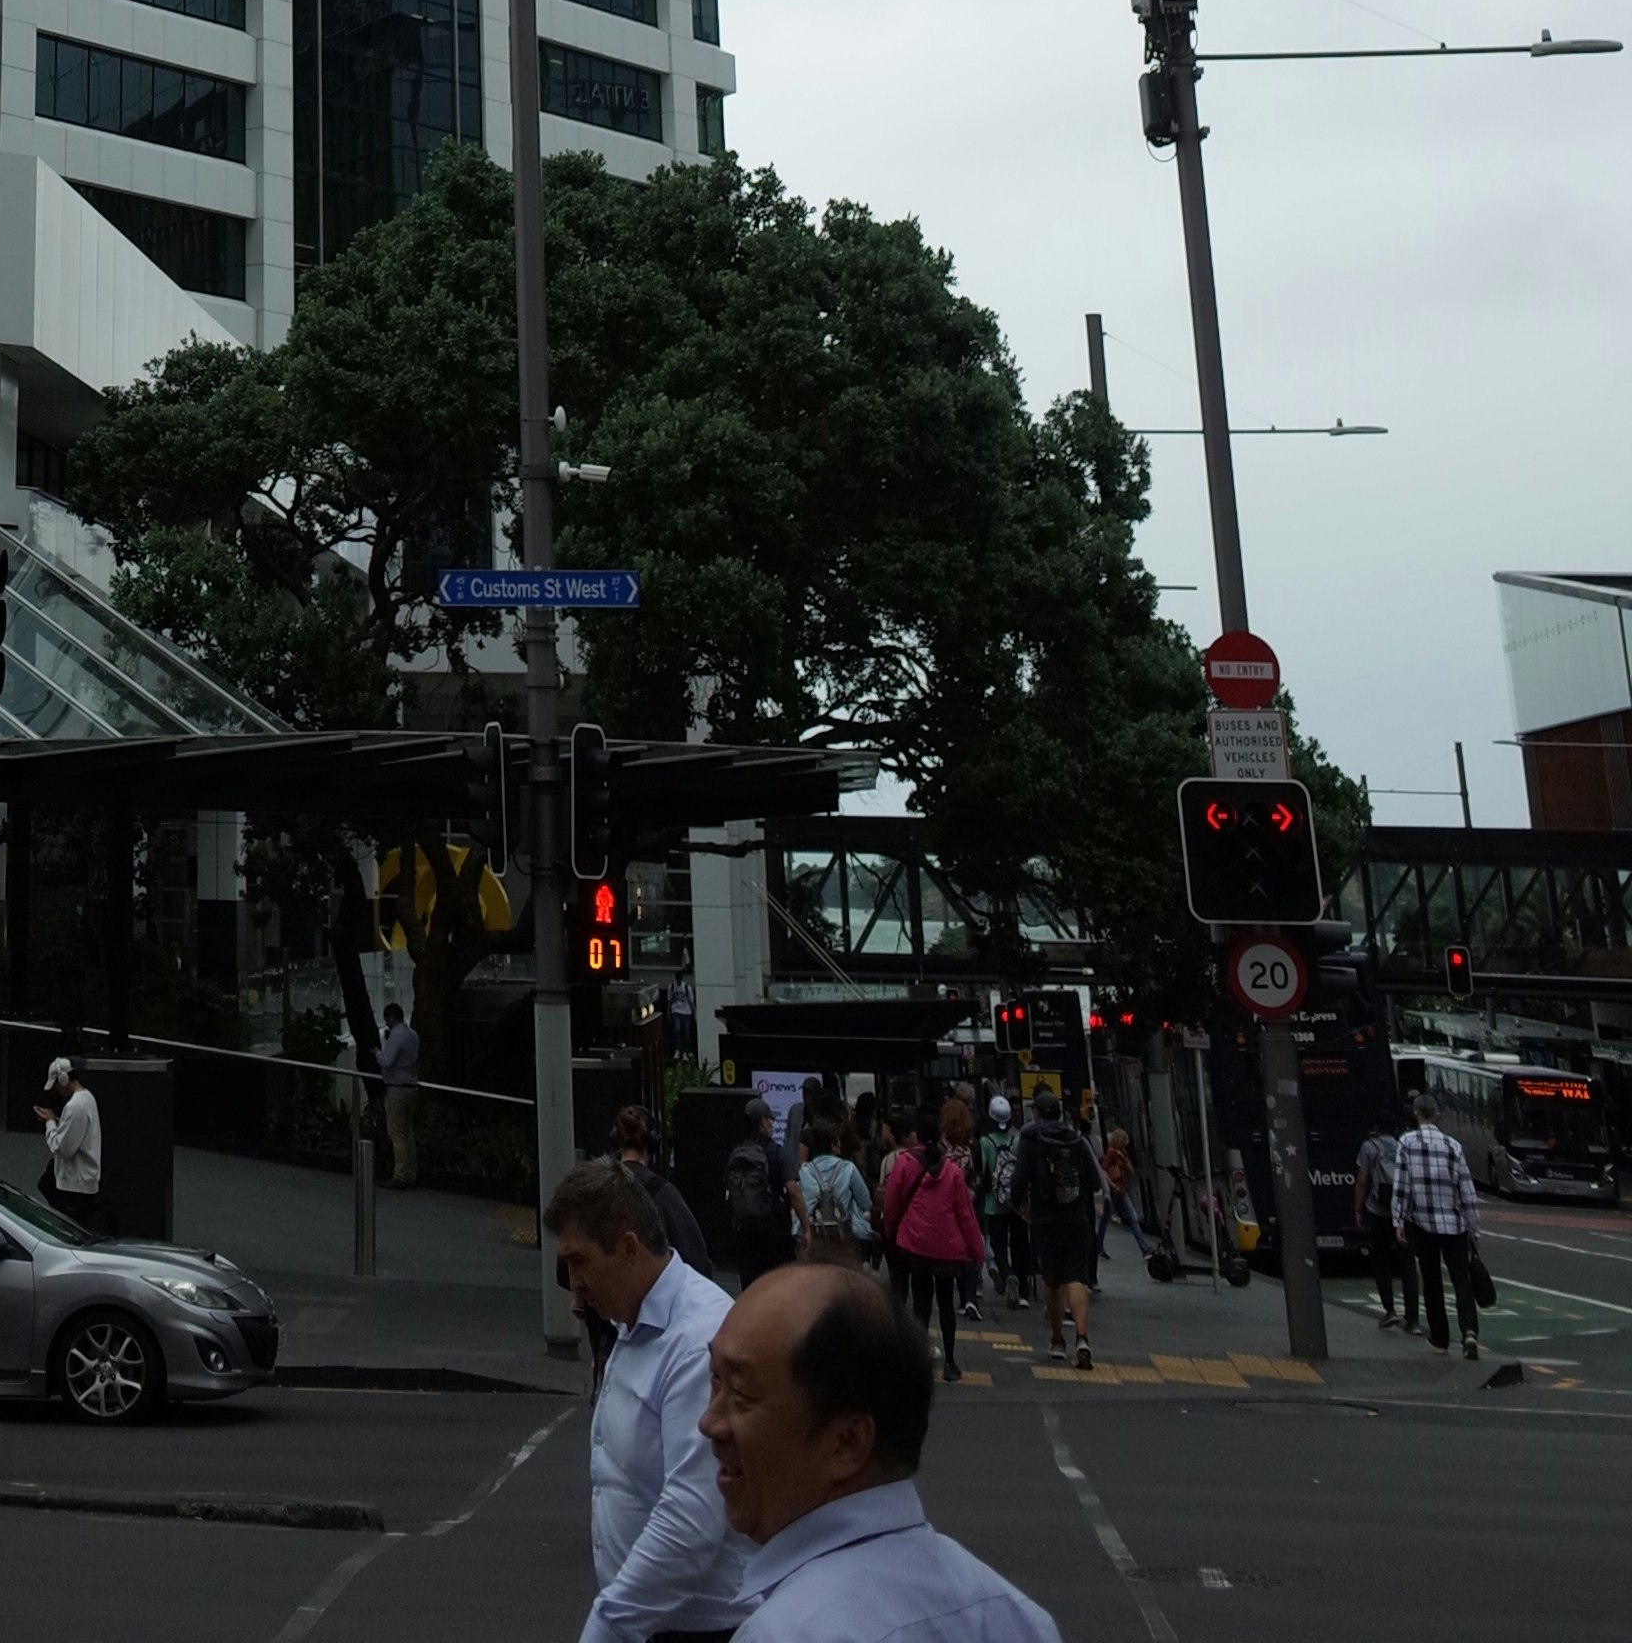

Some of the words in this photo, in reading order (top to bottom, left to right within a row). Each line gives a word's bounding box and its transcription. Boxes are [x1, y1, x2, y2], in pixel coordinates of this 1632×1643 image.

[470, 577, 540, 599] Customs
[544, 578, 563, 599] St
[565, 578, 607, 599] West
[1219, 664, 1231, 675] NO
[1237, 664, 1265, 676] ENTRY
[1215, 720, 1250, 731] BUSES
[1256, 720, 1278, 731] AND
[1215, 736, 1283, 747] AUTHORISED
[1224, 752, 1276, 763] VEHICLES
[1237, 768, 1265, 779] ONLY
[589, 938, 621, 969] 07
[1250, 961, 1288, 989] 20
[770, 1083, 797, 1093] news
[1308, 1169, 1356, 1186] Metro
